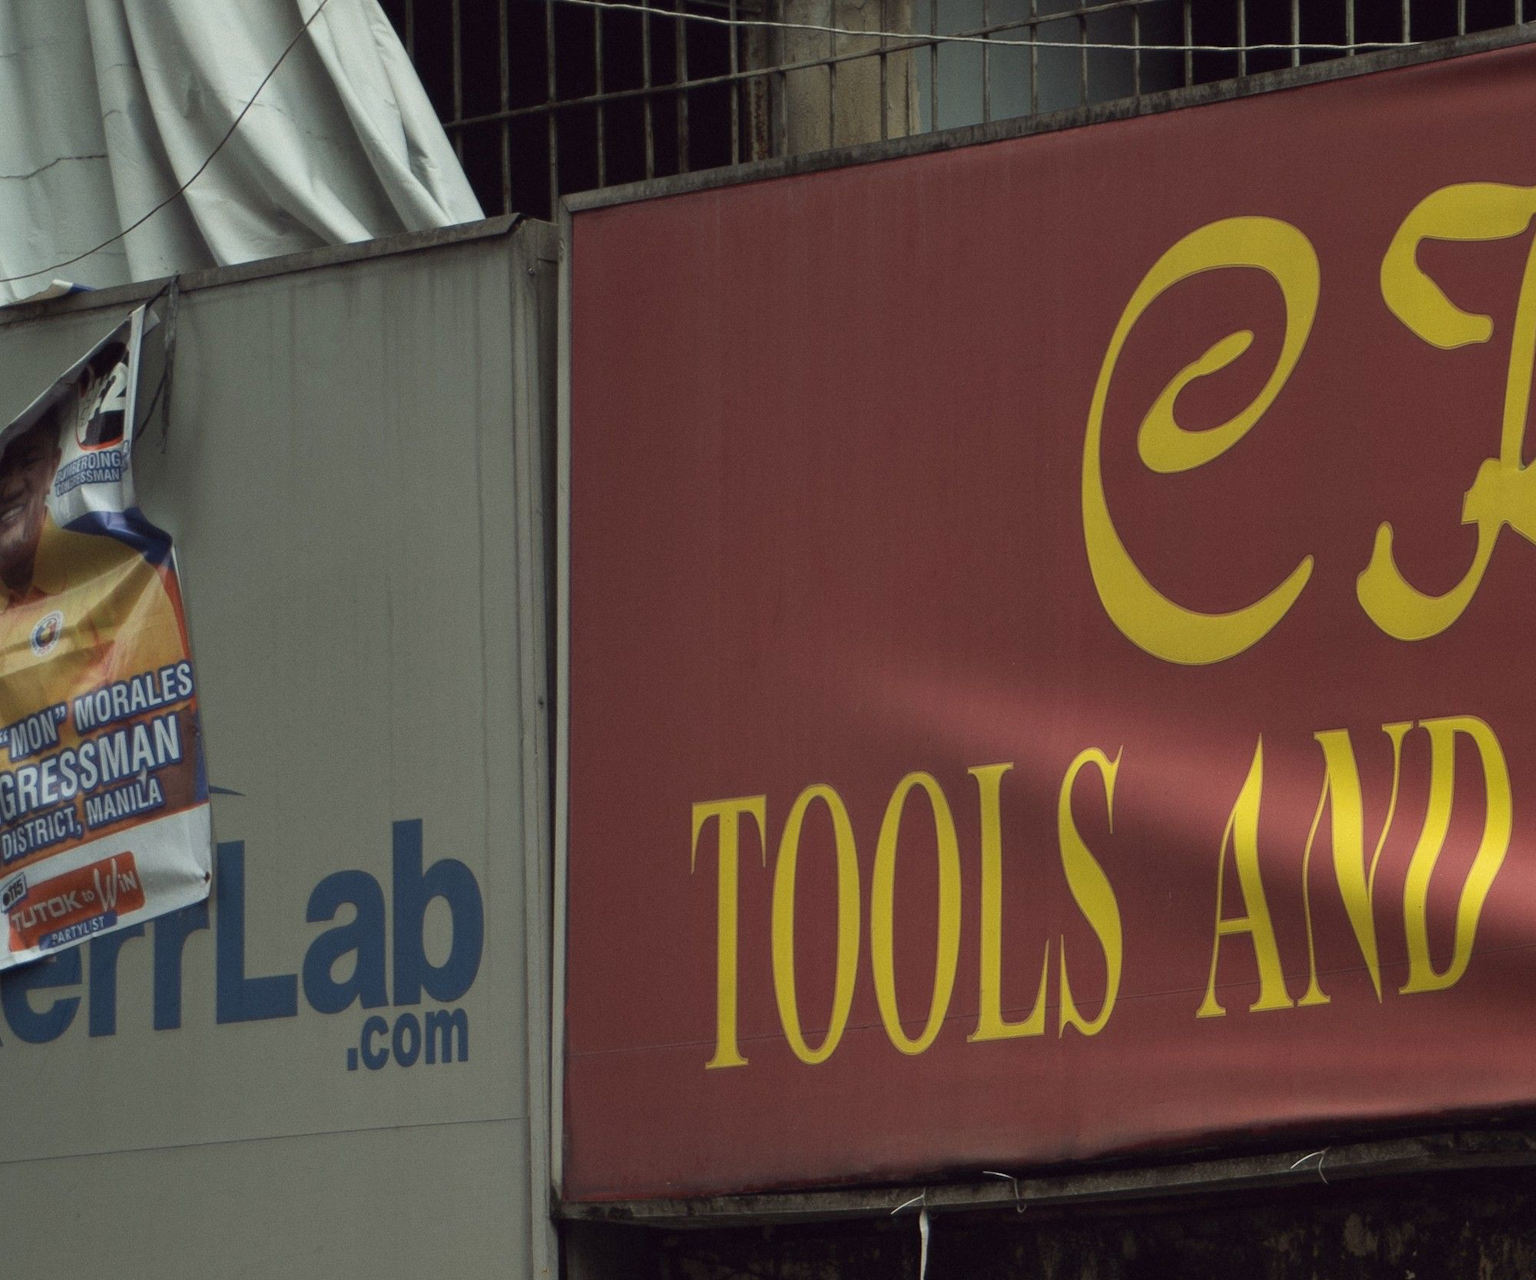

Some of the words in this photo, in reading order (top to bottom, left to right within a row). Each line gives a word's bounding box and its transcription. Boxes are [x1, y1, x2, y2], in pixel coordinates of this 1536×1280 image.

[75, 663, 192, 731] MORALES
[2, 806, 82, 859] DISTRICT,
[86, 777, 163, 826] MANILA
[11, 890, 83, 932] TUTOK
[82, 889, 95, 903] to
[690, 744, 1123, 1070] TOOLS
[1195, 713, 1514, 1018] AND
[0, 817, 484, 1046] errLab
[52, 916, 105, 945] PARTYLIST
[347, 1006, 470, 1071] .com
